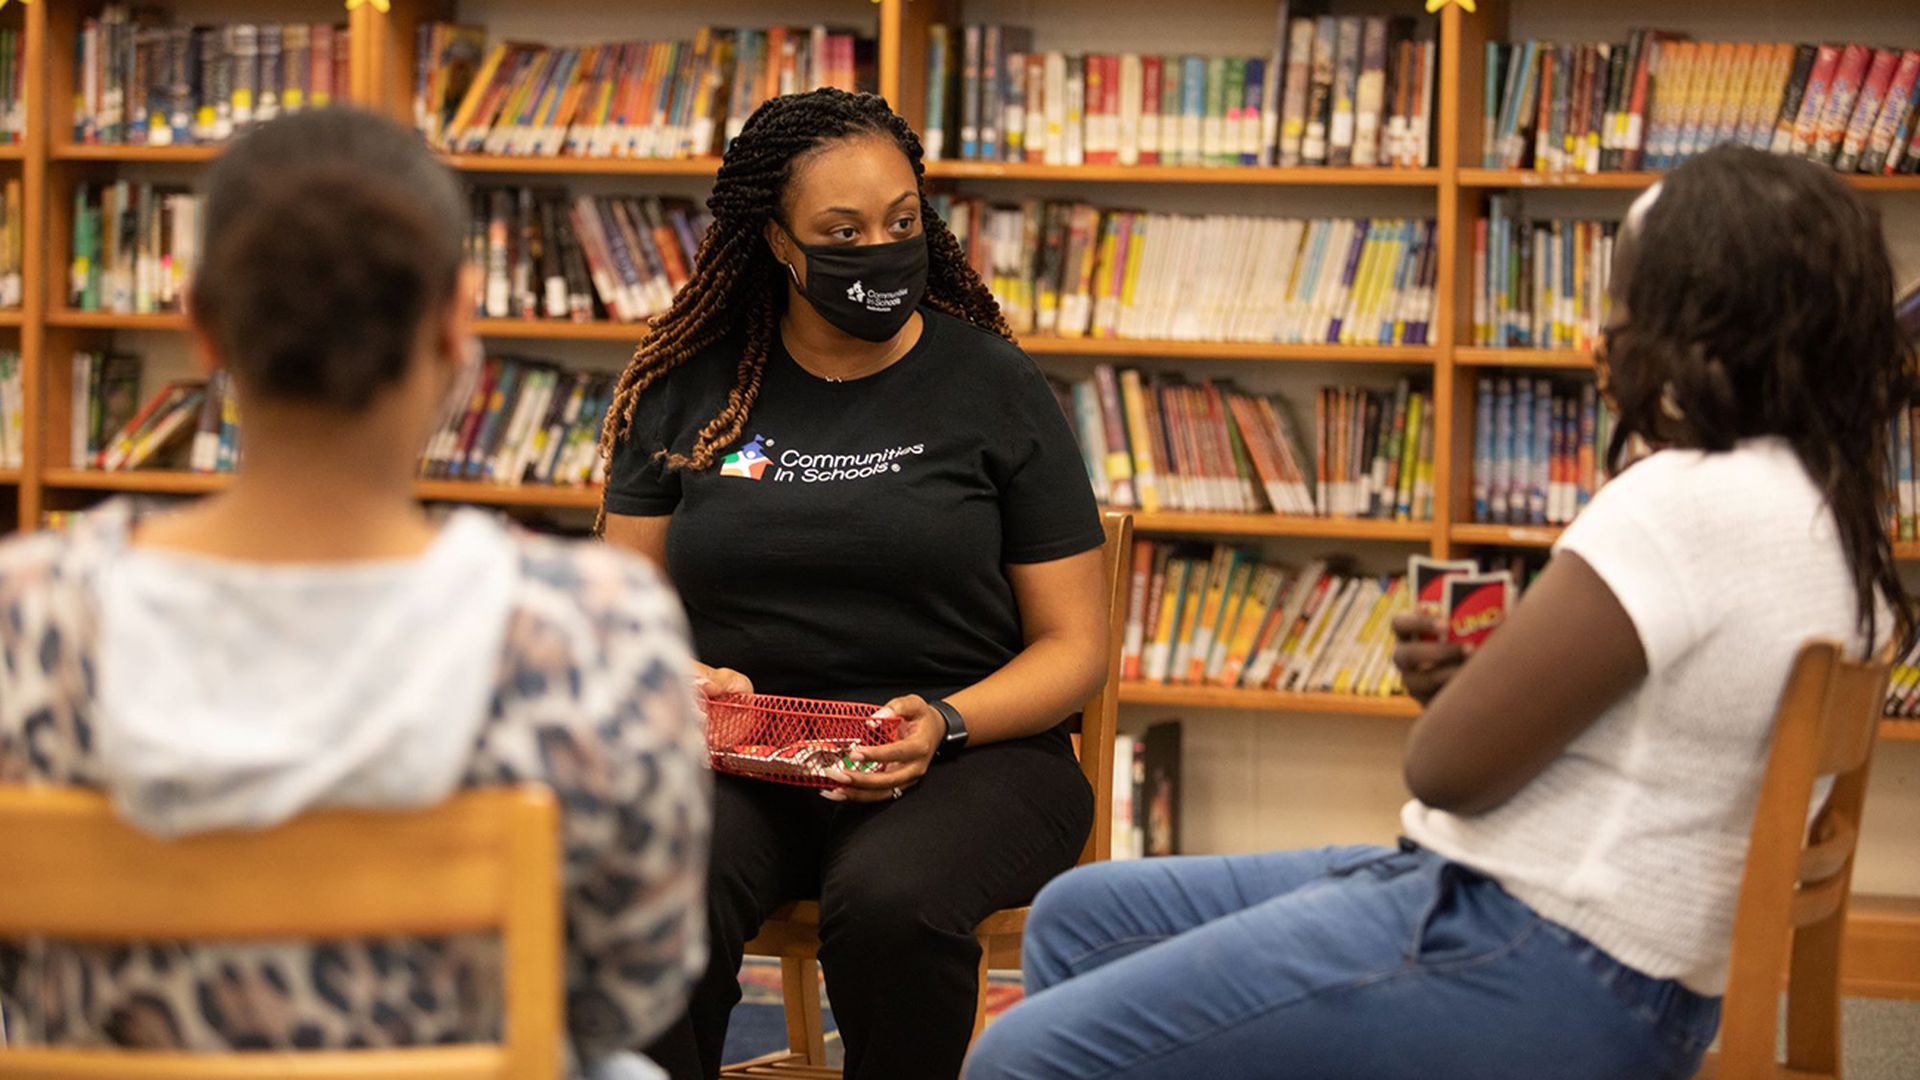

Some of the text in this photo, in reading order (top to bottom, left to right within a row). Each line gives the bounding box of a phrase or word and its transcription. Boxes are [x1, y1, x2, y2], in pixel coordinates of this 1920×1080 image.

[780, 443, 924, 468] Communities
[774, 462, 888, 483] In Schools
